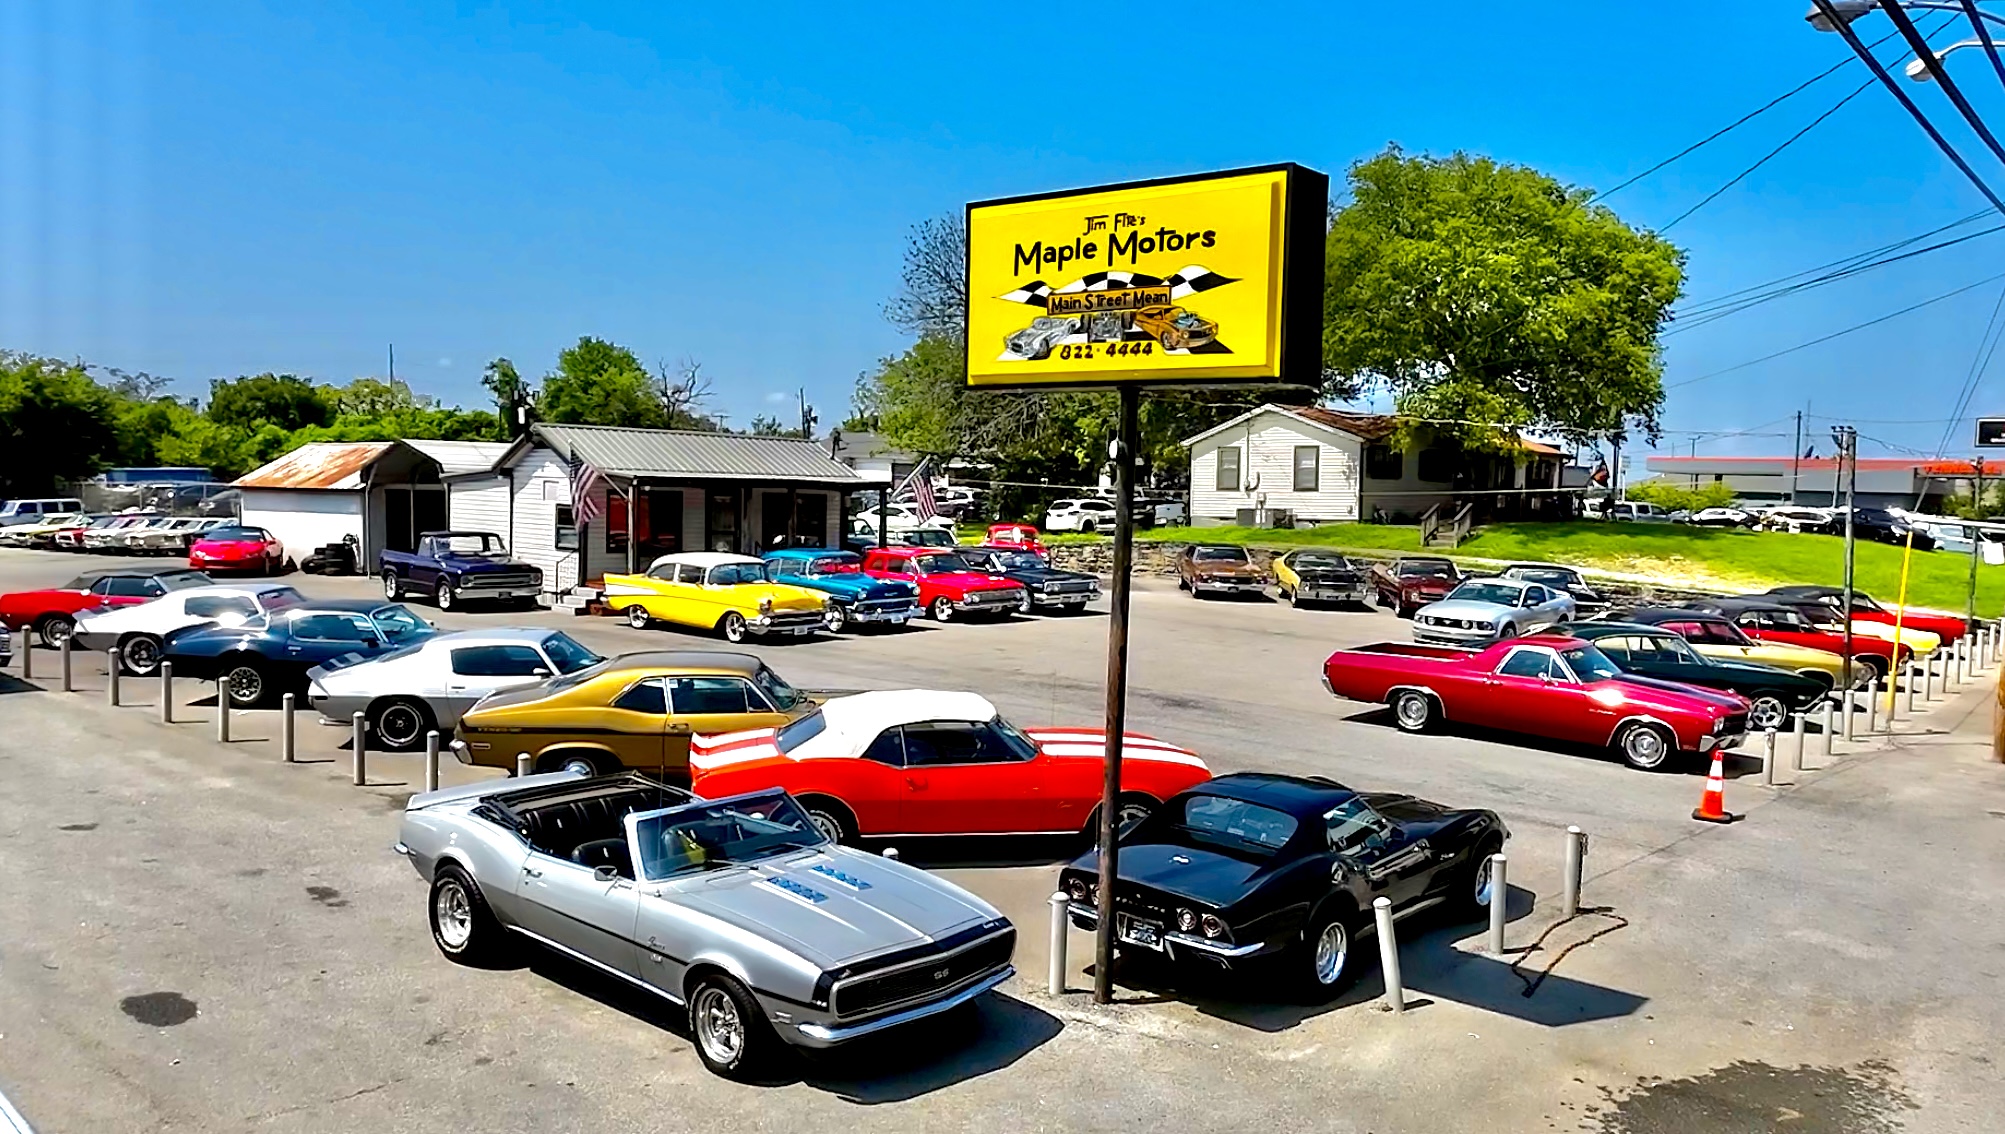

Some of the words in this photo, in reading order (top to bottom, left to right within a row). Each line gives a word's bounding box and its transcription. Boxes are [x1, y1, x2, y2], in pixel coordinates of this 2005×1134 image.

[1082, 214, 1109, 236] Jim
[1013, 237, 1098, 277] Maple
[1107, 227, 1217, 267] Motors
[1051, 296, 1082, 313] Main
[1084, 292, 1131, 310] Street
[1132, 290, 1169, 308] Mean
